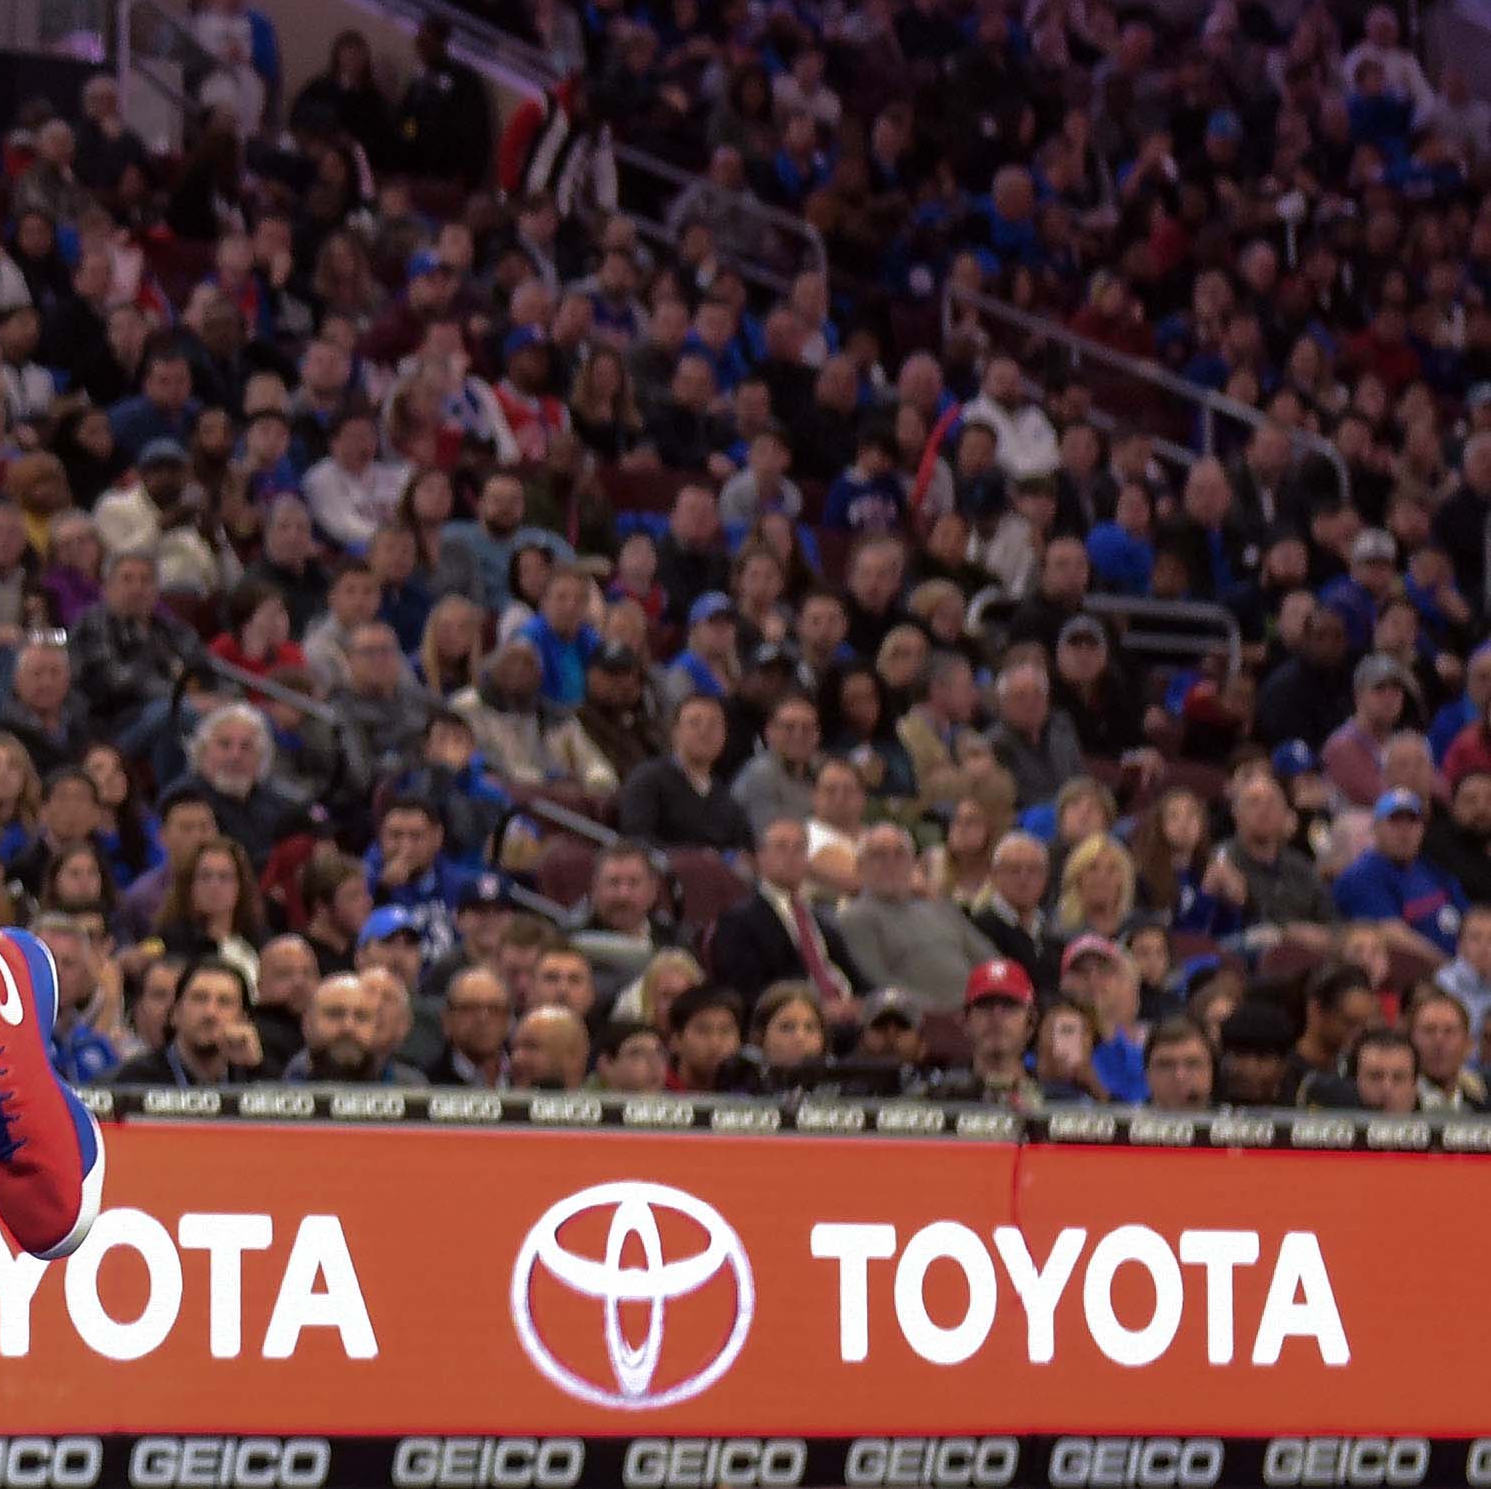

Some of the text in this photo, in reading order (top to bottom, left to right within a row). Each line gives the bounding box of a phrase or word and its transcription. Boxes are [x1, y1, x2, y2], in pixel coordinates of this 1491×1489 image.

[810, 1220, 1352, 1367] TOYOTA
[128, 1437, 331, 1486] GEICO
[392, 1437, 584, 1486] GEICO
[623, 1437, 807, 1487] GEICO
[844, 1437, 1019, 1487] GEICO
[1049, 1437, 1224, 1486] GEICO
[1263, 1437, 1430, 1485] GEICO
